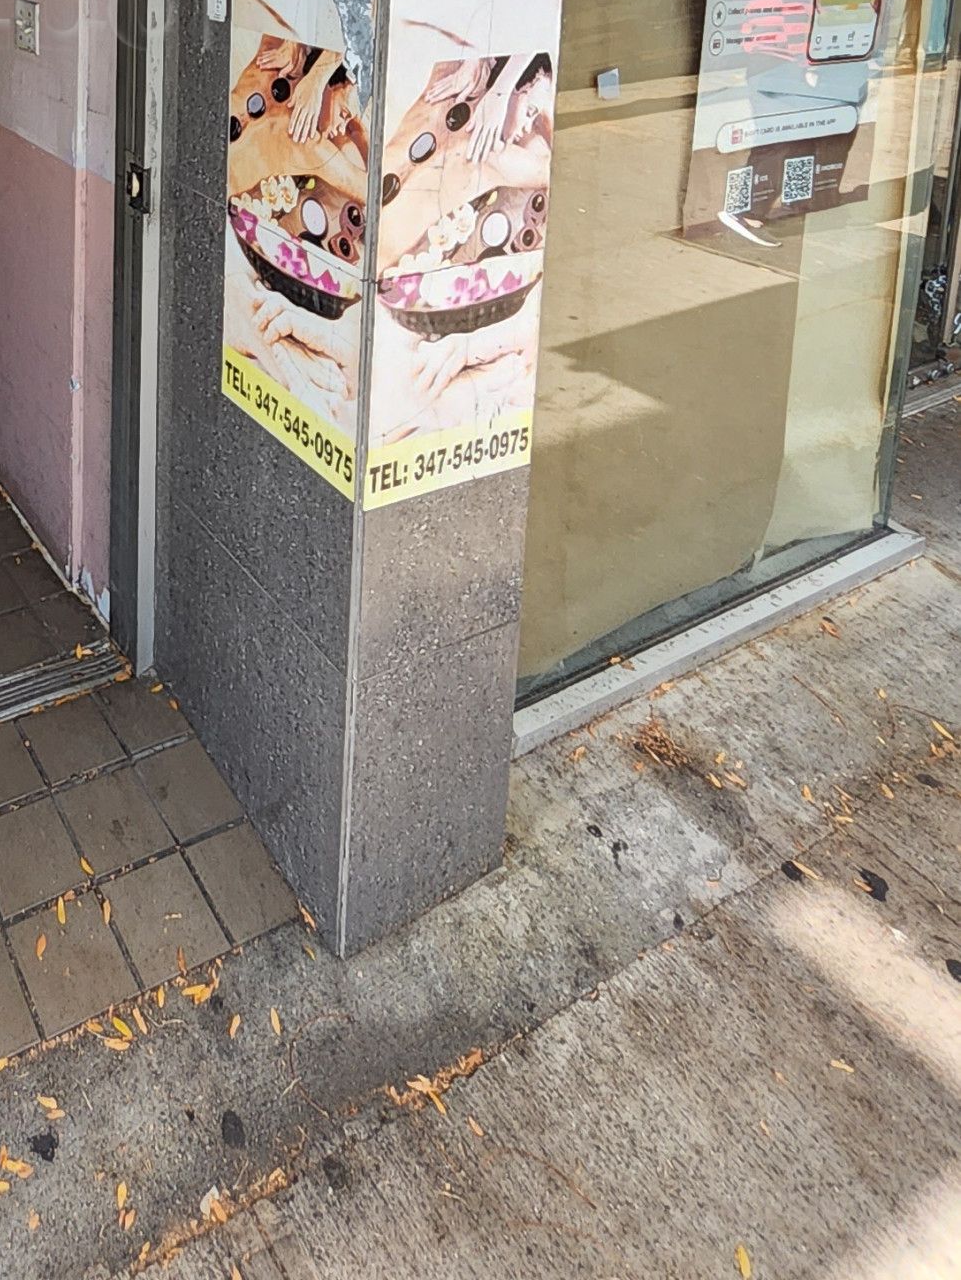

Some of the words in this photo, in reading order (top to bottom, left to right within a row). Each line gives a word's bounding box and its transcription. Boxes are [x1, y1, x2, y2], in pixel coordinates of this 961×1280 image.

[225, 359, 252, 401] TEL:
[254, 384, 354, 484] 347-545-0975
[370, 461, 409, 494] TEL:
[414, 426, 530, 483] 347-545-0975
